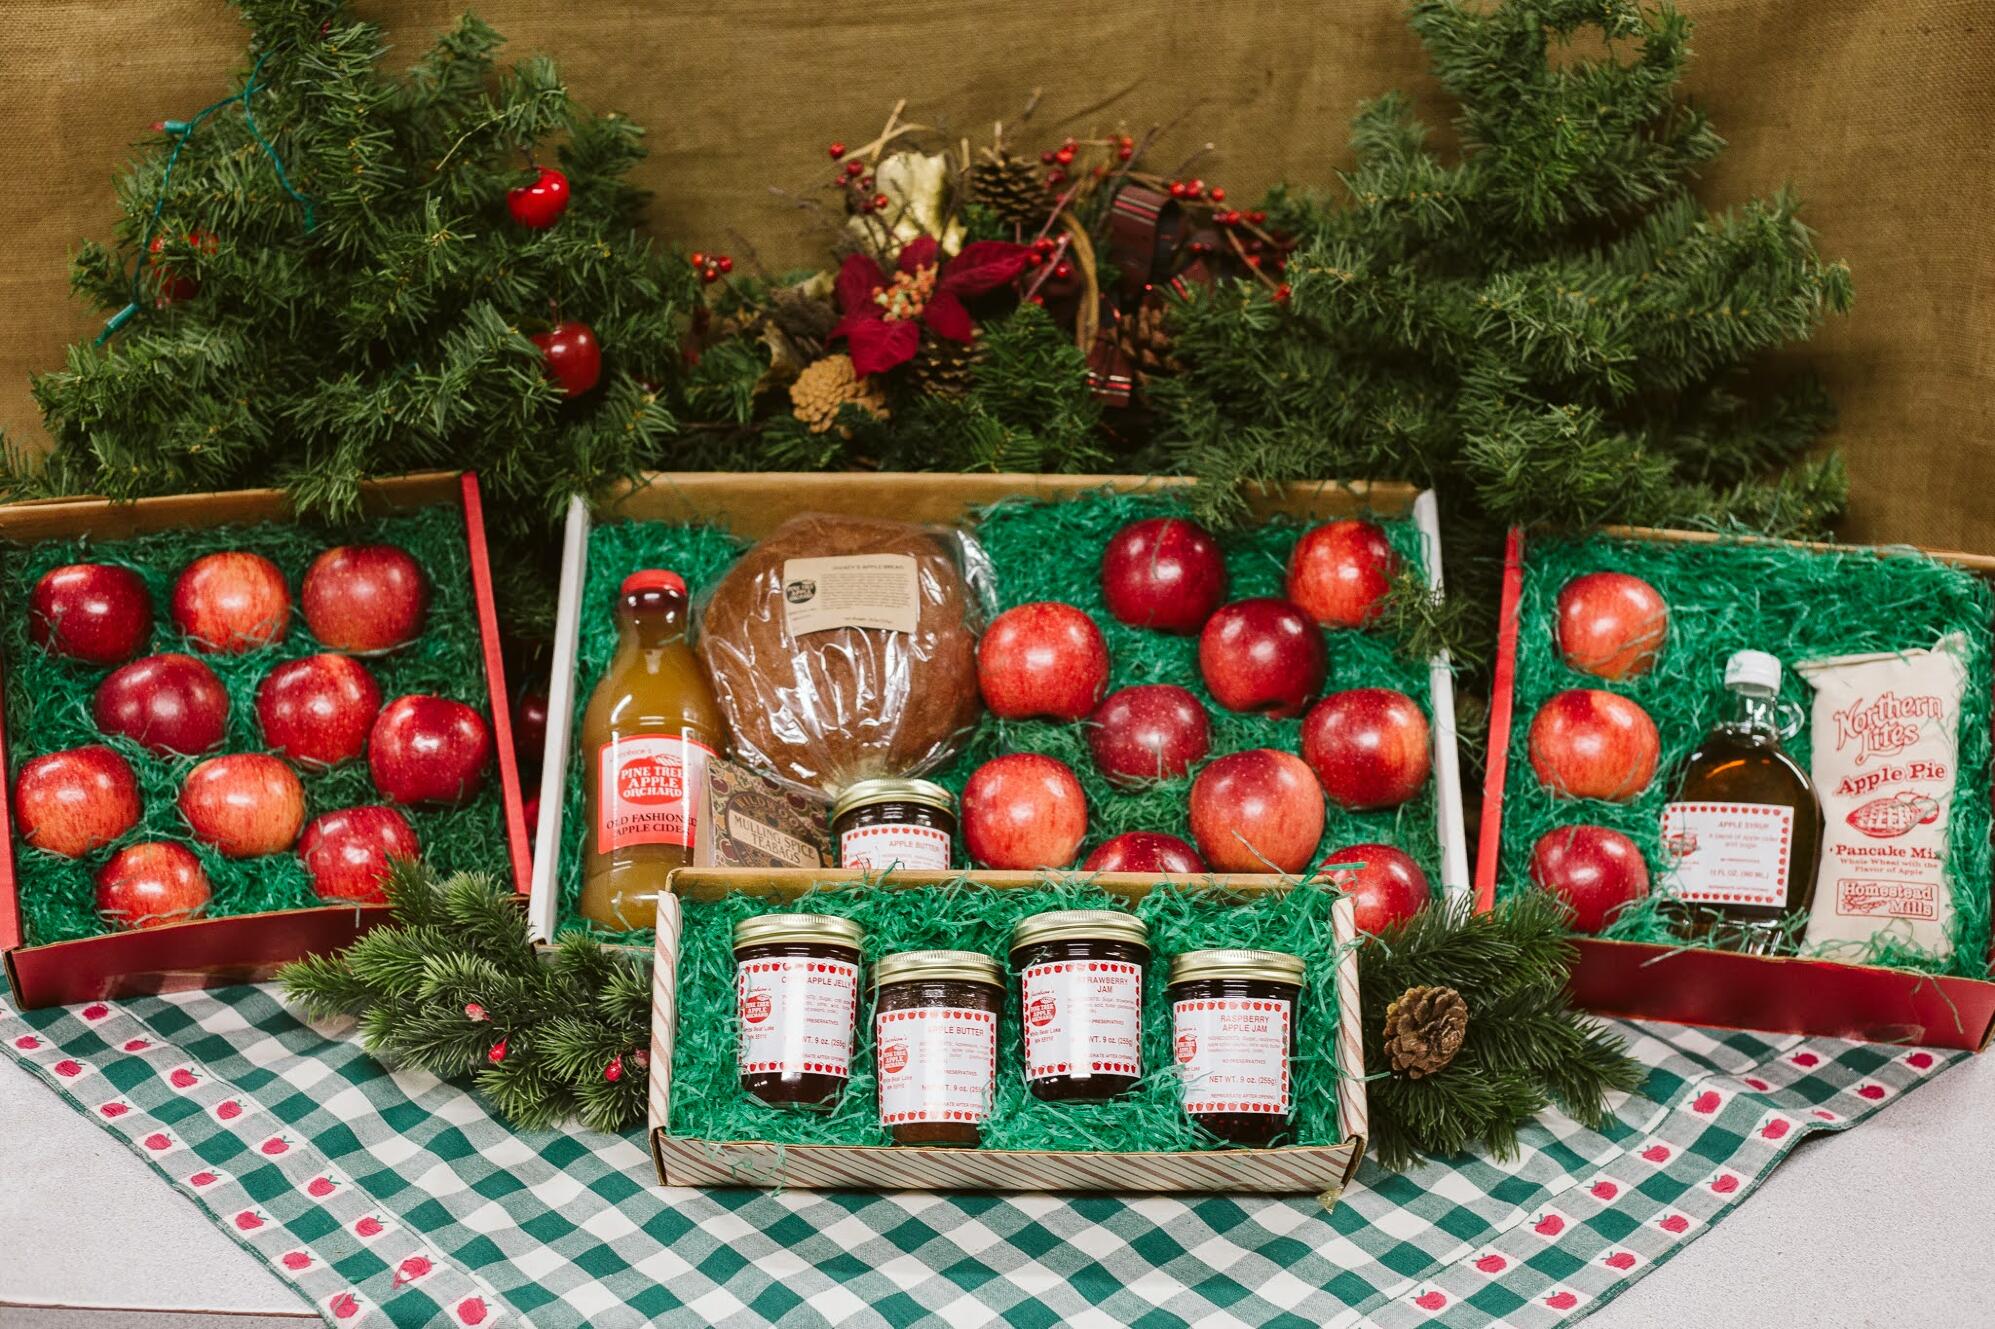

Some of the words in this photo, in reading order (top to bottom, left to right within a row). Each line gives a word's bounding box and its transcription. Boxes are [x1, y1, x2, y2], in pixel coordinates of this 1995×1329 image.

[1832, 691, 1944, 751] Northern
[1855, 720, 1920, 766] Lites
[621, 766, 651, 780] PINE
[1836, 767, 1903, 796] Apple
[1909, 762, 1945, 779] Pie
[629, 776, 679, 788] APPLE
[622, 787, 682, 798] ORCHARD
[606, 816, 628, 830] OD
[632, 812, 697, 827] FASHIOND
[617, 824, 650, 836] APPLE
[734, 814, 781, 842] MULLING
[784, 838, 815, 860] SPICE
[751, 831, 801, 864] TEABAGS
[1836, 844, 1906, 858] Pancake
[1843, 880, 1933, 900] Homestead
[1888, 900, 1933, 916] Mills
[807, 976, 832, 986] APPLE
[1079, 976, 1128, 984] TRAWBERRY
[1097, 985, 1112, 993] JAM
[1220, 1014, 1270, 1023] RASPBERRY
[956, 1026, 984, 1036] BUTTER
[1208, 1076, 1223, 1084] NET
